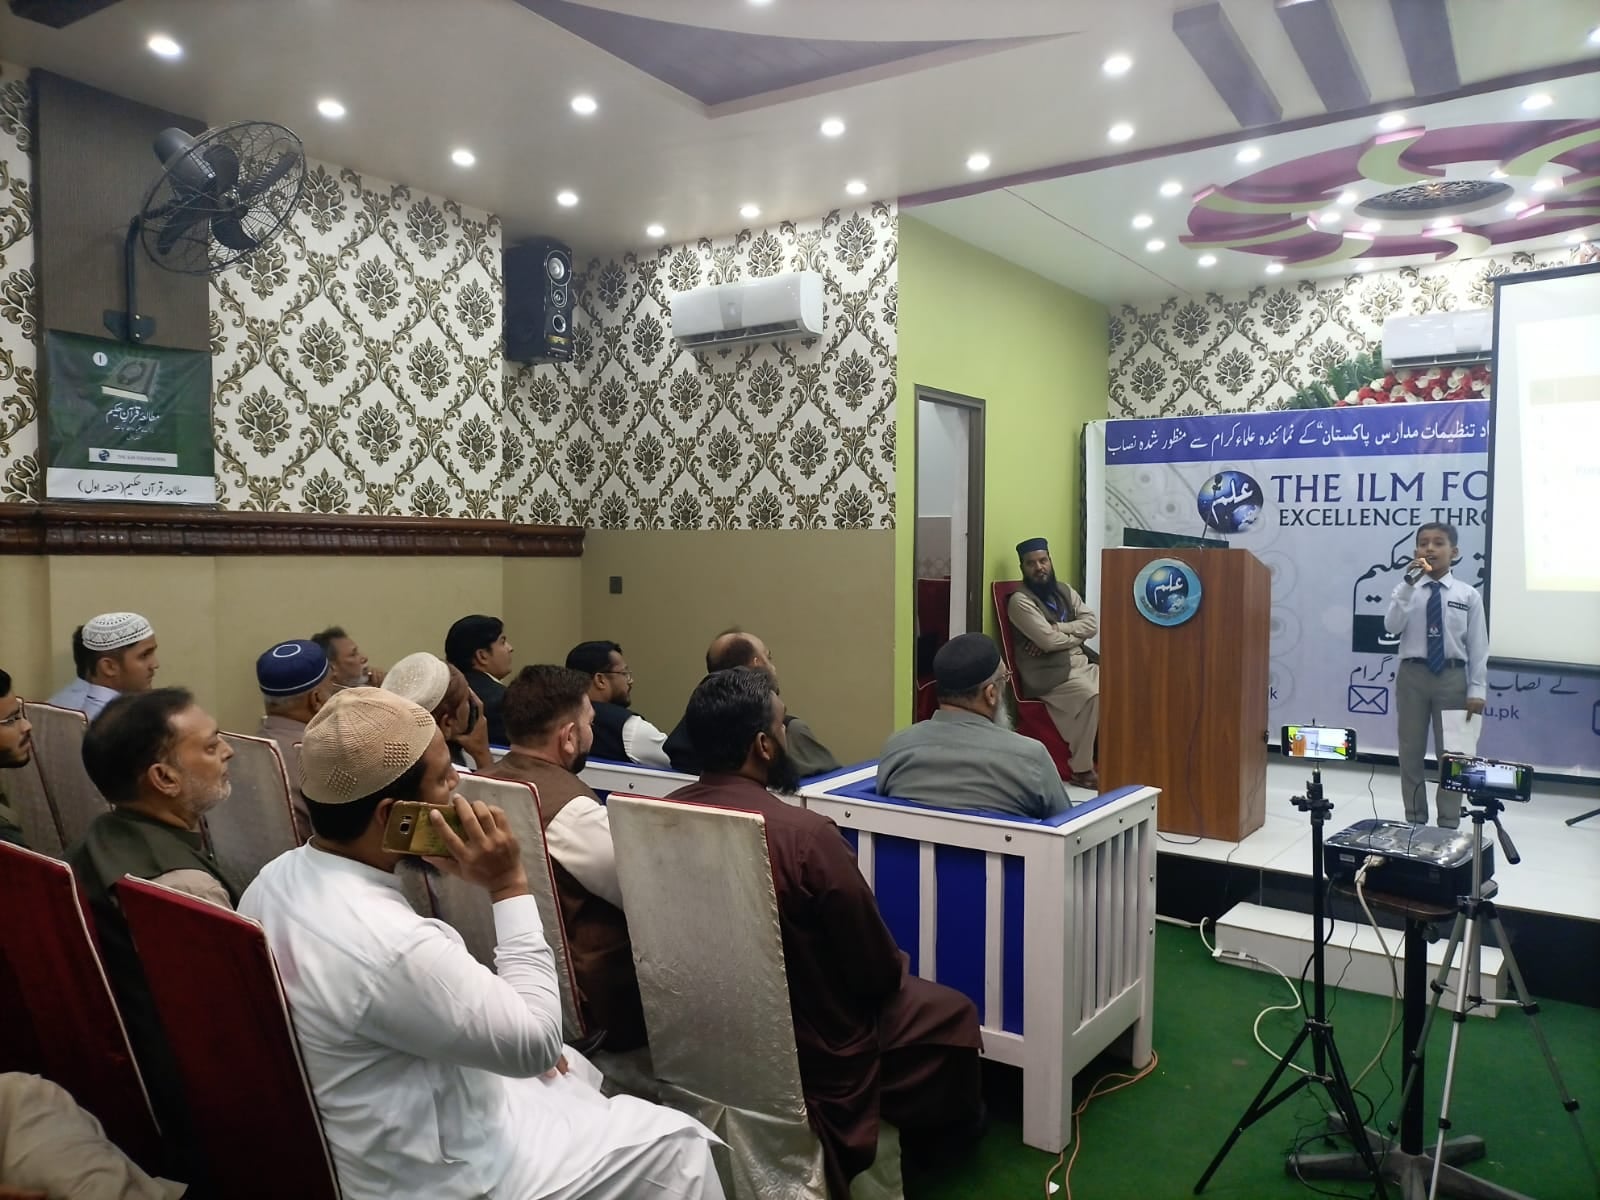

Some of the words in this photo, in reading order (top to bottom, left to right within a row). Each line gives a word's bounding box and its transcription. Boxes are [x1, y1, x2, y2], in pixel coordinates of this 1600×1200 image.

[1138, 429, 1159, 451] شدہ
[1161, 427, 1187, 450] منظور
[1189, 437, 1209, 449] سے
[1258, 423, 1295, 446] نمائندہ
[1299, 419, 1317, 445] کے
[1374, 420, 1419, 445] مدارس
[1421, 420, 1476, 443] تنظیمات
[1107, 435, 1137, 456] نصاب
[1270, 473, 1342, 503] THE
[1357, 471, 1425, 502] ILM
[1441, 470, 1488, 502] FO
[1279, 507, 1422, 527] EXCELLENCE
[1430, 506, 1488, 526] THR
[1484, 704, 1520, 721] u.pk
